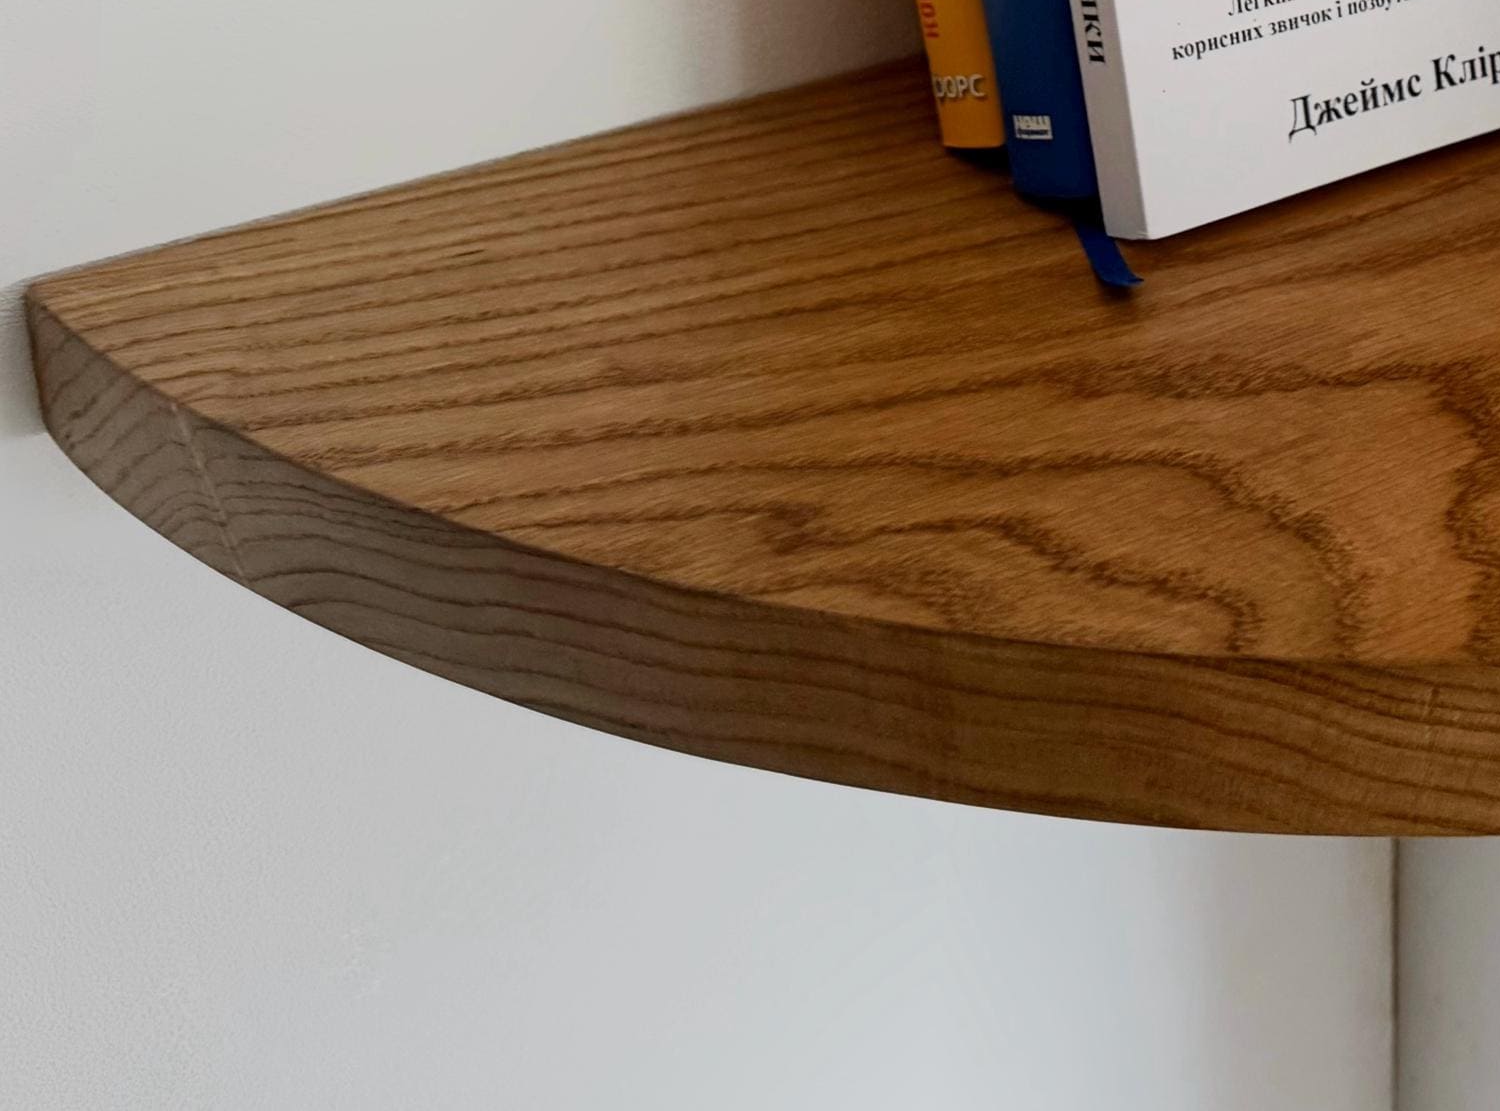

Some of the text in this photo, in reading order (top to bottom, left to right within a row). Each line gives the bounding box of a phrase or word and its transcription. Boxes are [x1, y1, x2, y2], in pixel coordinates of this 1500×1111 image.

[1171, 23, 1264, 62] корисних
[1268, 7, 1333, 37] звичок
[1336, 0, 1344, 19] і
[1286, 72, 1423, 144] Джеймс
